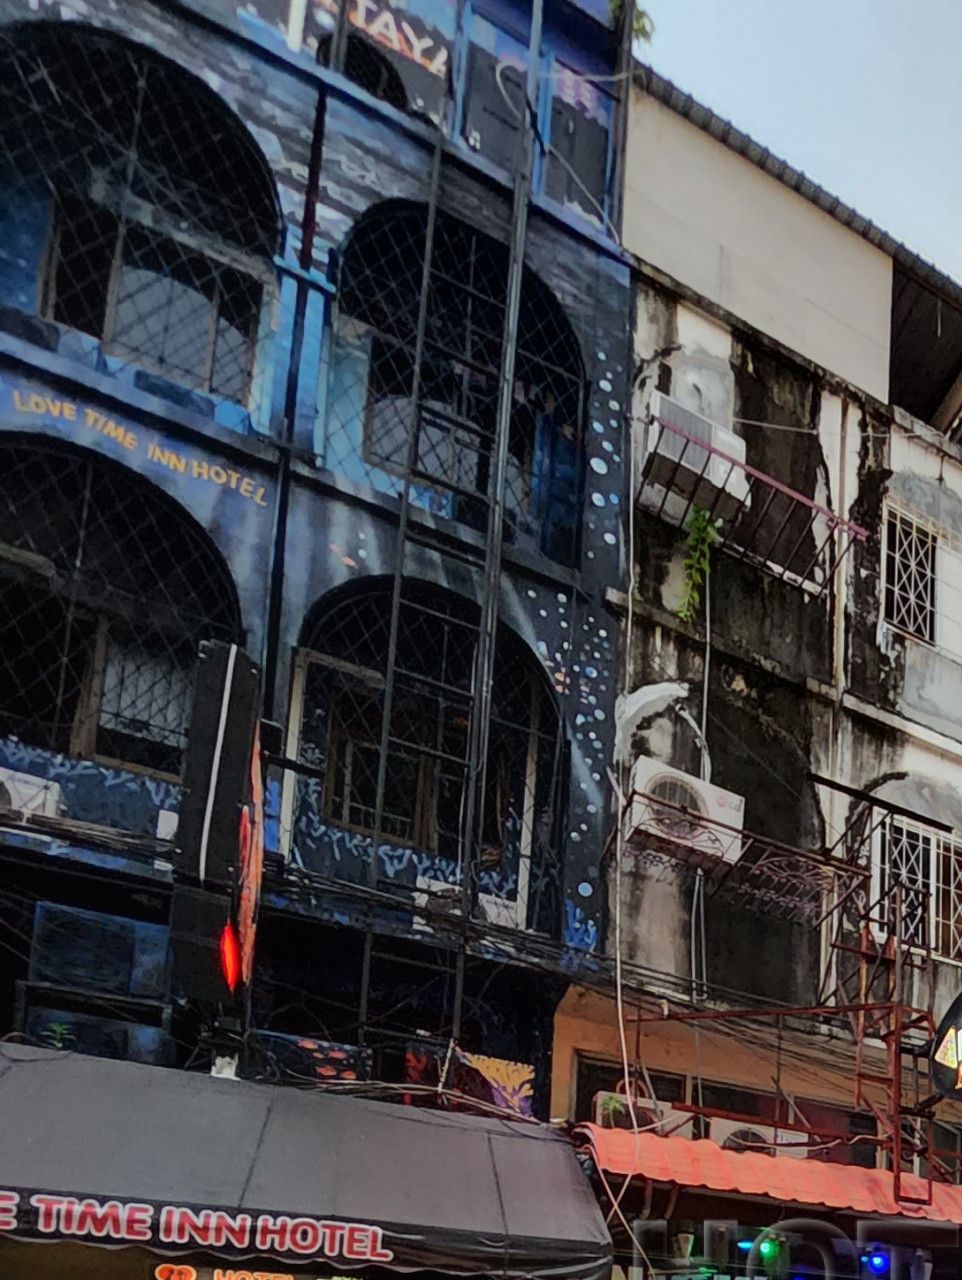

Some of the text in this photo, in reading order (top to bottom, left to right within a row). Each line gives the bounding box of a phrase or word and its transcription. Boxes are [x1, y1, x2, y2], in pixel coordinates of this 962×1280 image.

[12, 389, 269, 506] LOVE TIME INN HOTEL
[31, 1195, 154, 1240] TIME
[160, 1207, 251, 1249] INN
[256, 1215, 394, 1261] HOTEL
